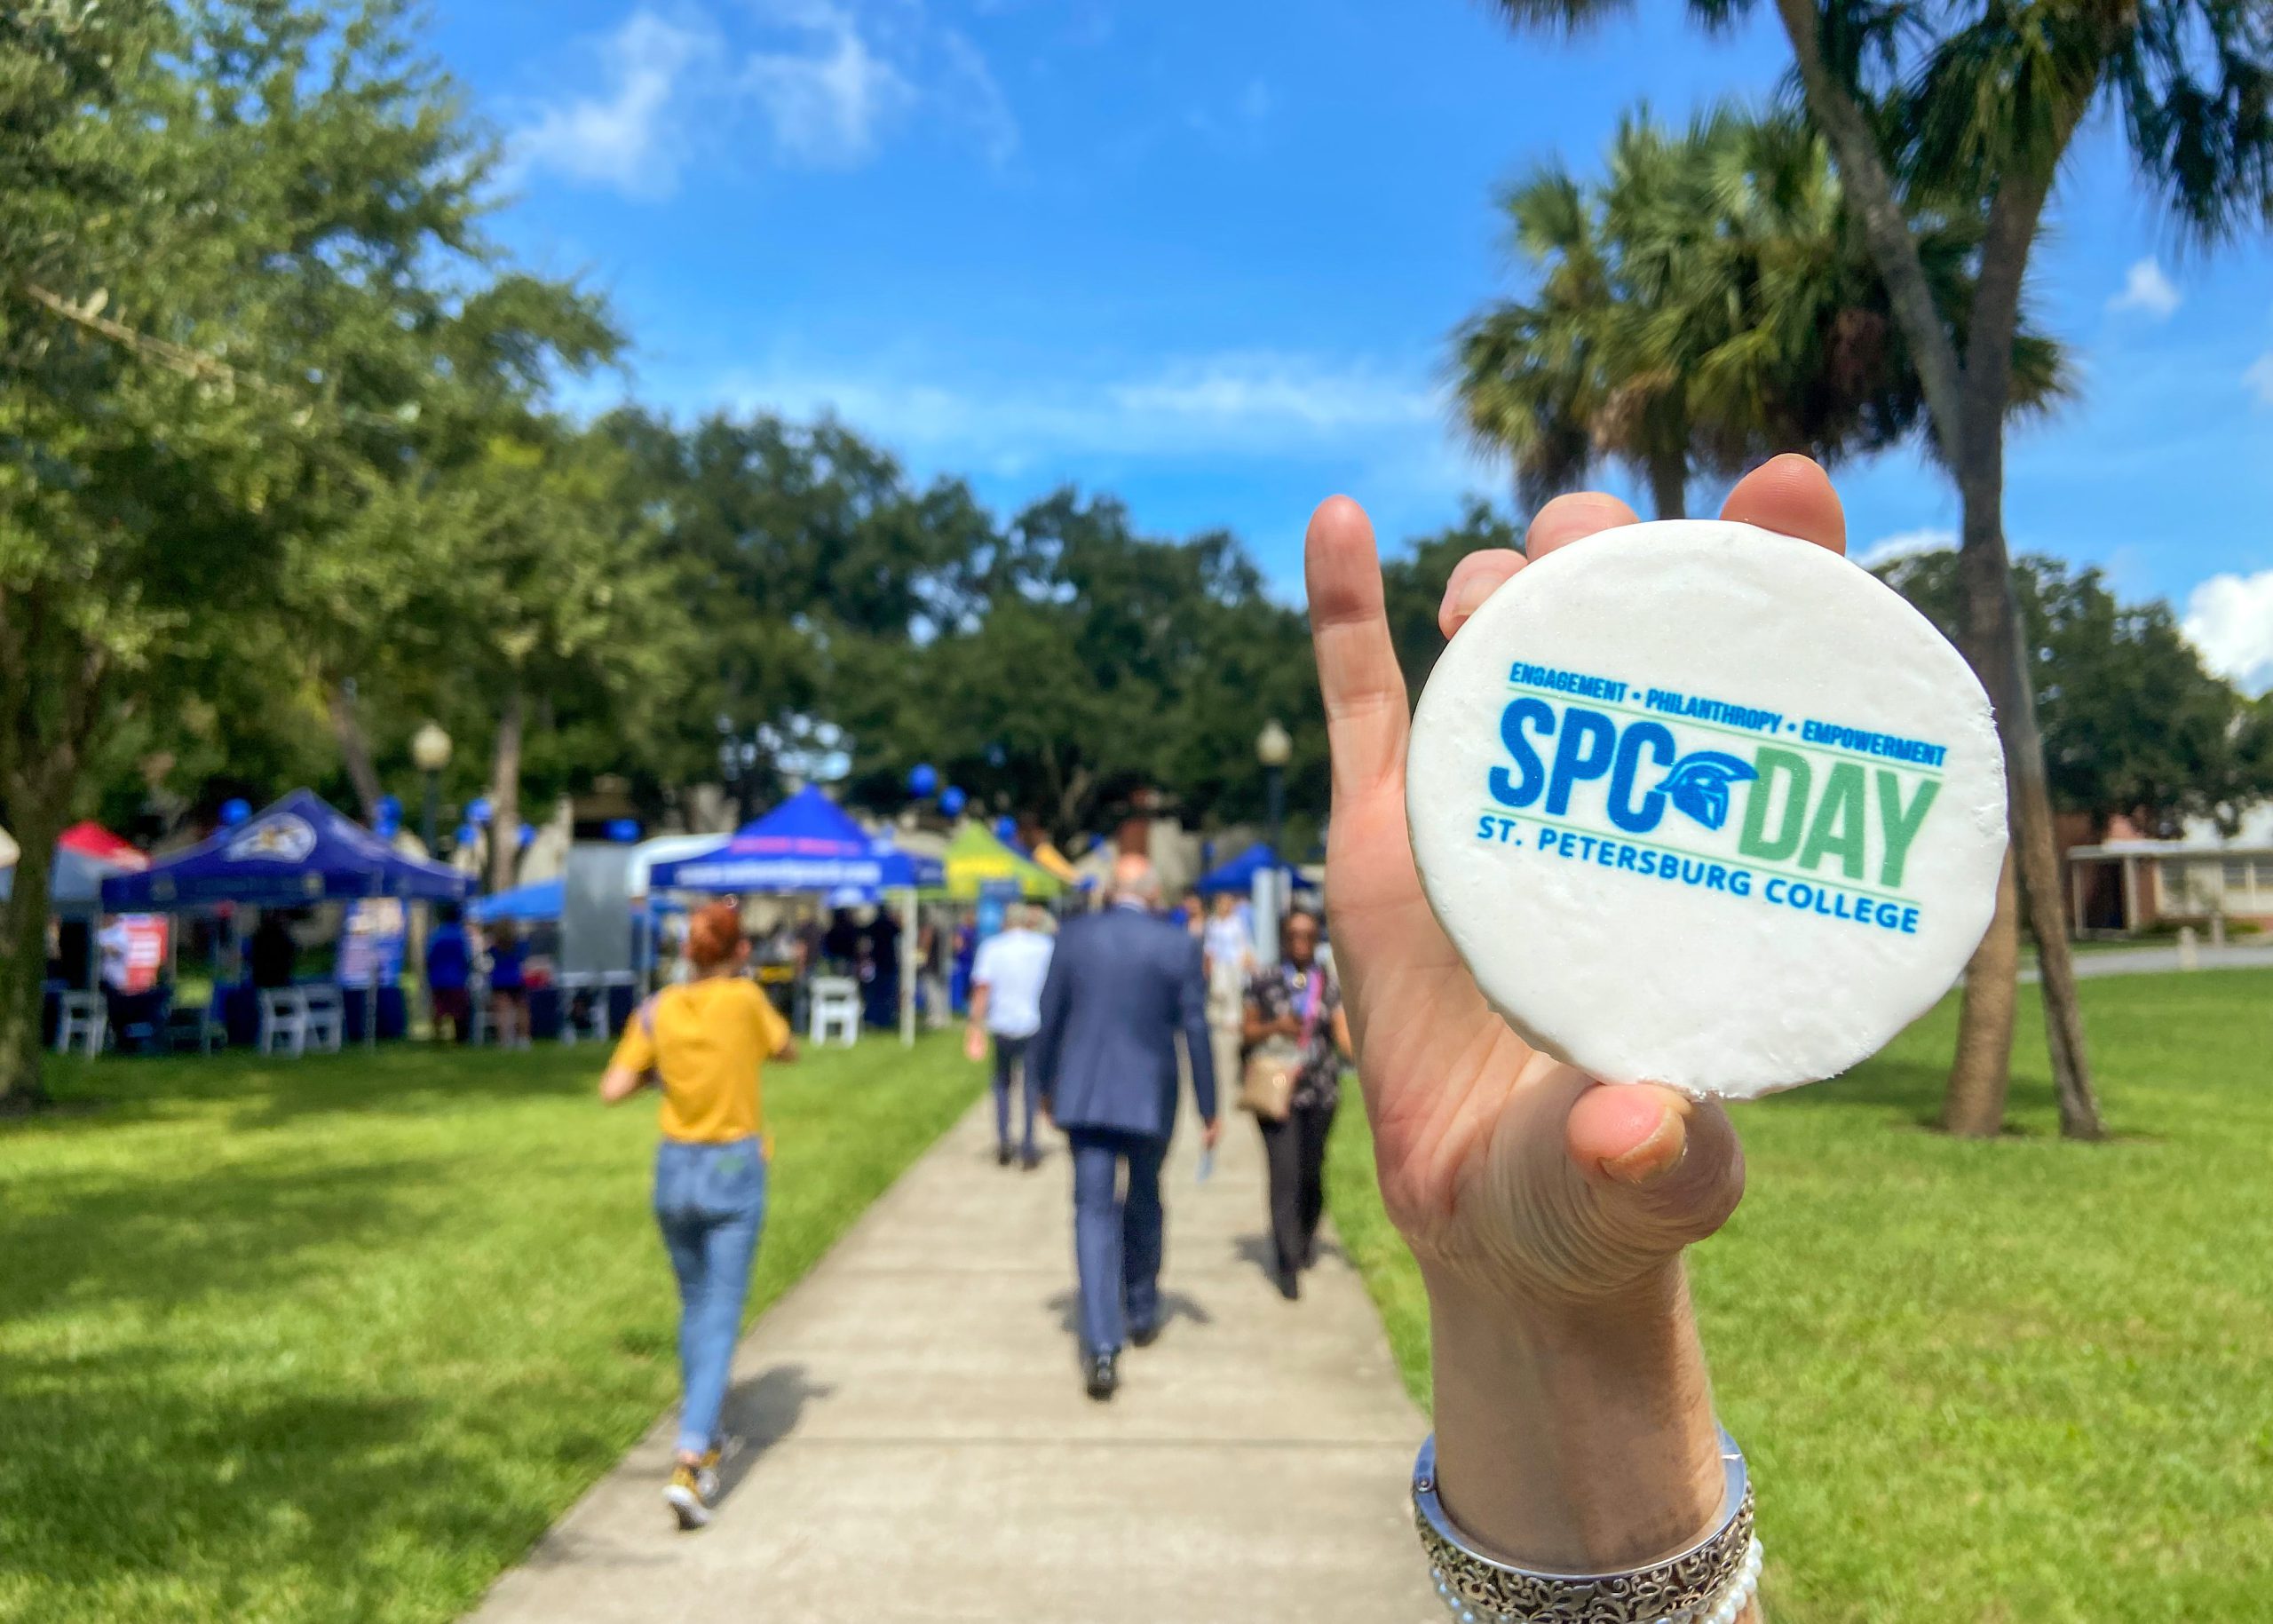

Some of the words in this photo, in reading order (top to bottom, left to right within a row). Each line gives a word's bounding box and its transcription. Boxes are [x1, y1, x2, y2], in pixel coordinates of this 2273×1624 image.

[1510, 662, 1628, 702] ENGAGEMENT
[1645, 689, 1782, 733] PHILANTHROPY
[1802, 721, 1947, 767] EMPOWERMENT
[1489, 698, 1675, 833] SPC
[1738, 746, 1942, 888] DAY
[1477, 816, 1522, 846] ST.
[1539, 827, 1752, 896] PETERSBURG
[1765, 878, 1921, 933] COLLEGE
